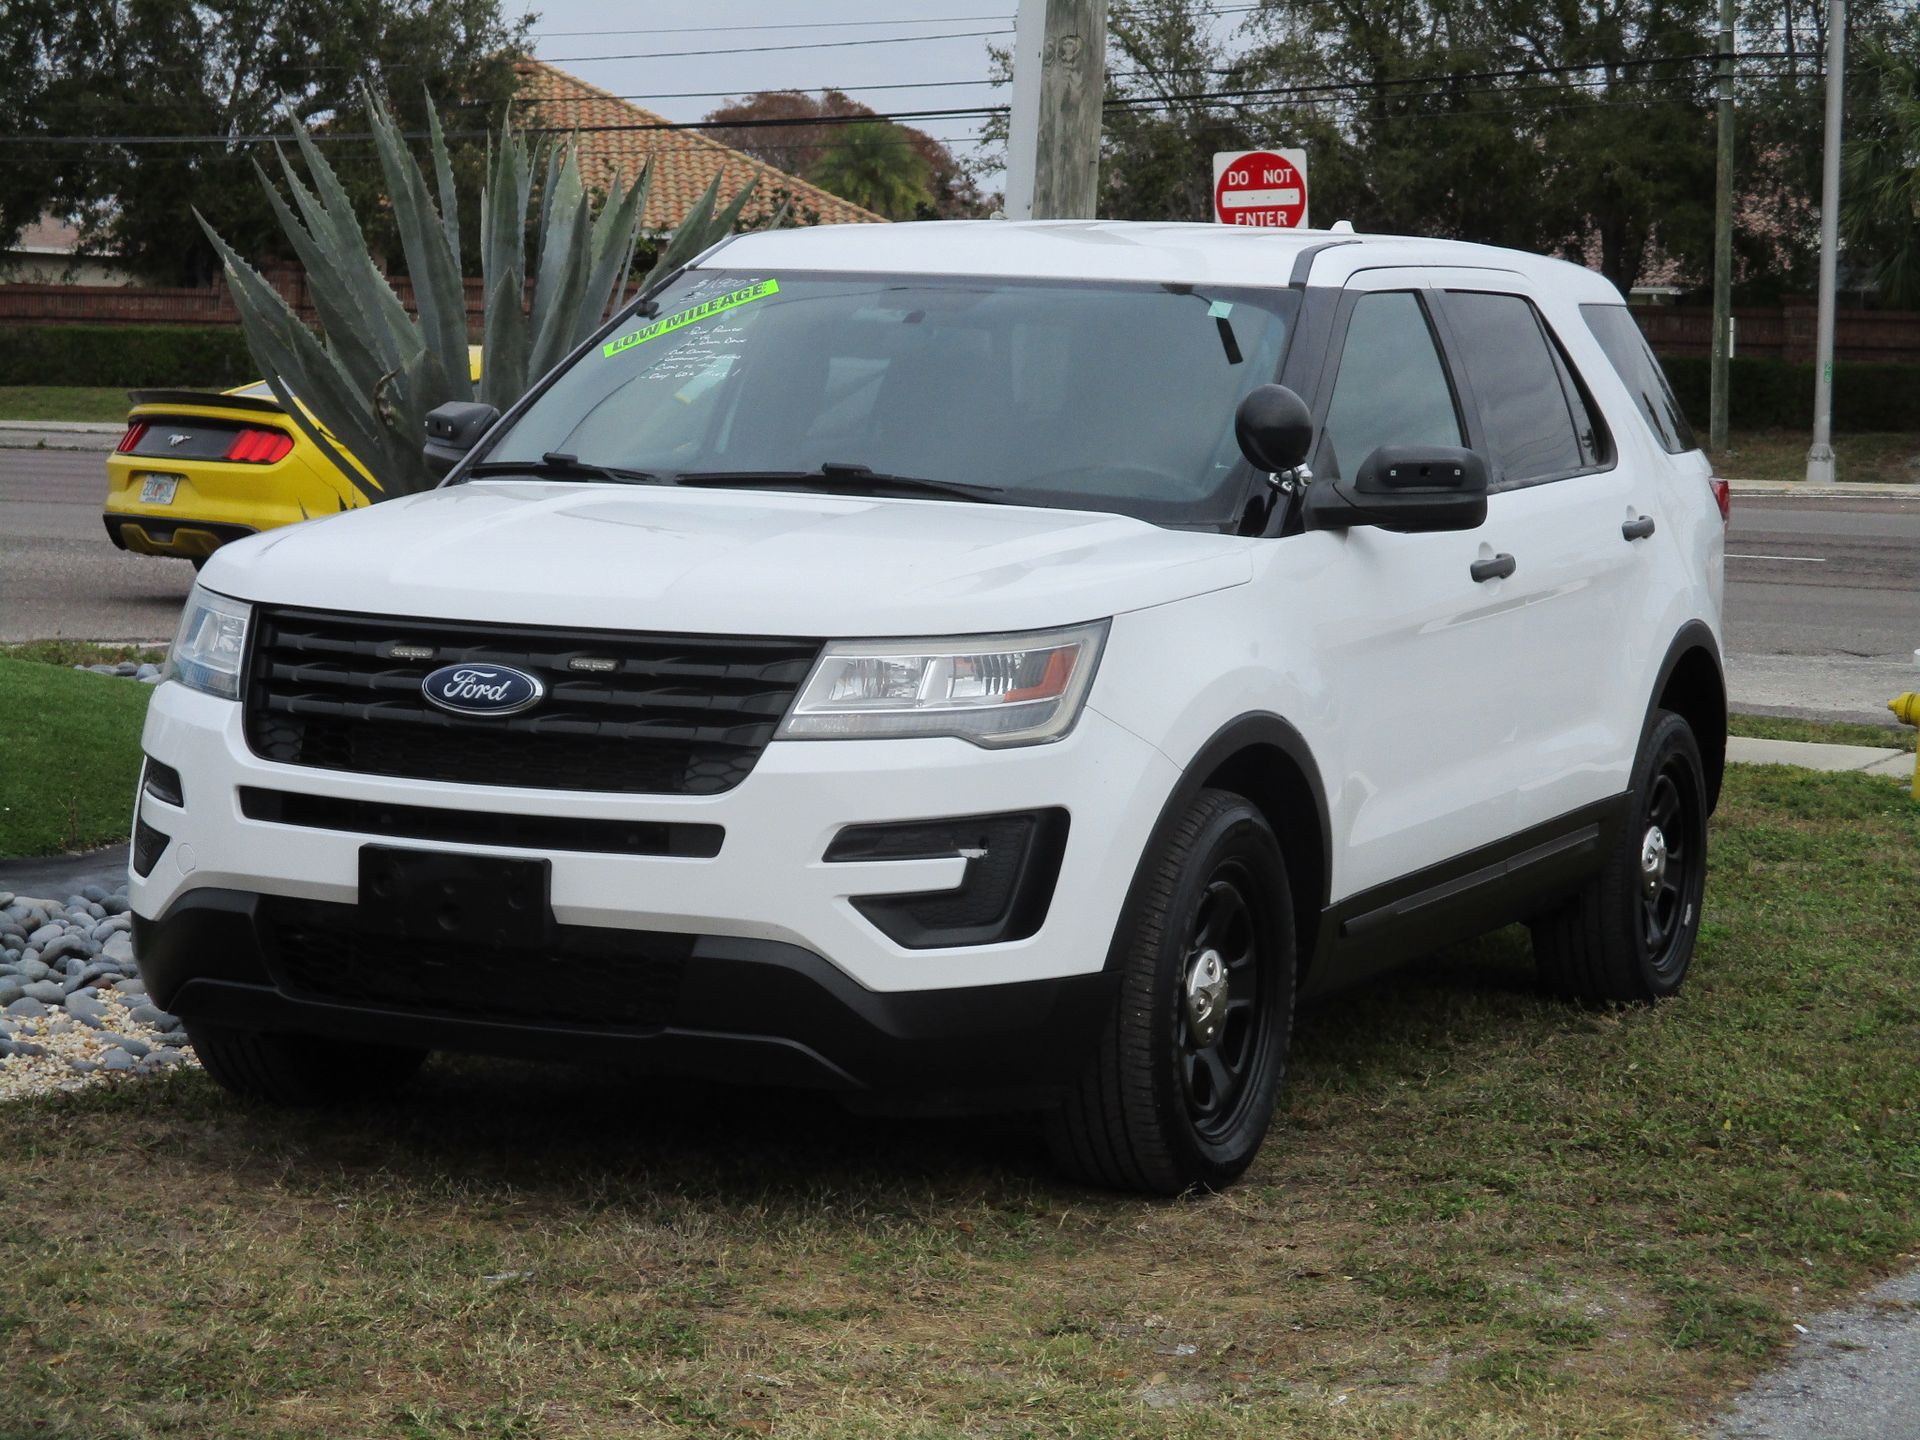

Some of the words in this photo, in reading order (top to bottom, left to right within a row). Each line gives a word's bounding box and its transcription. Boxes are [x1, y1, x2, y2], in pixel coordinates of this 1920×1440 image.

[1228, 170, 1249, 186] DO
[1263, 168, 1293, 184] NOT
[1235, 211, 1288, 227] ENTER
[612, 321, 661, 351] LOW
[666, 283, 766, 329] MILEAGE
[443, 669, 512, 701] Ford
